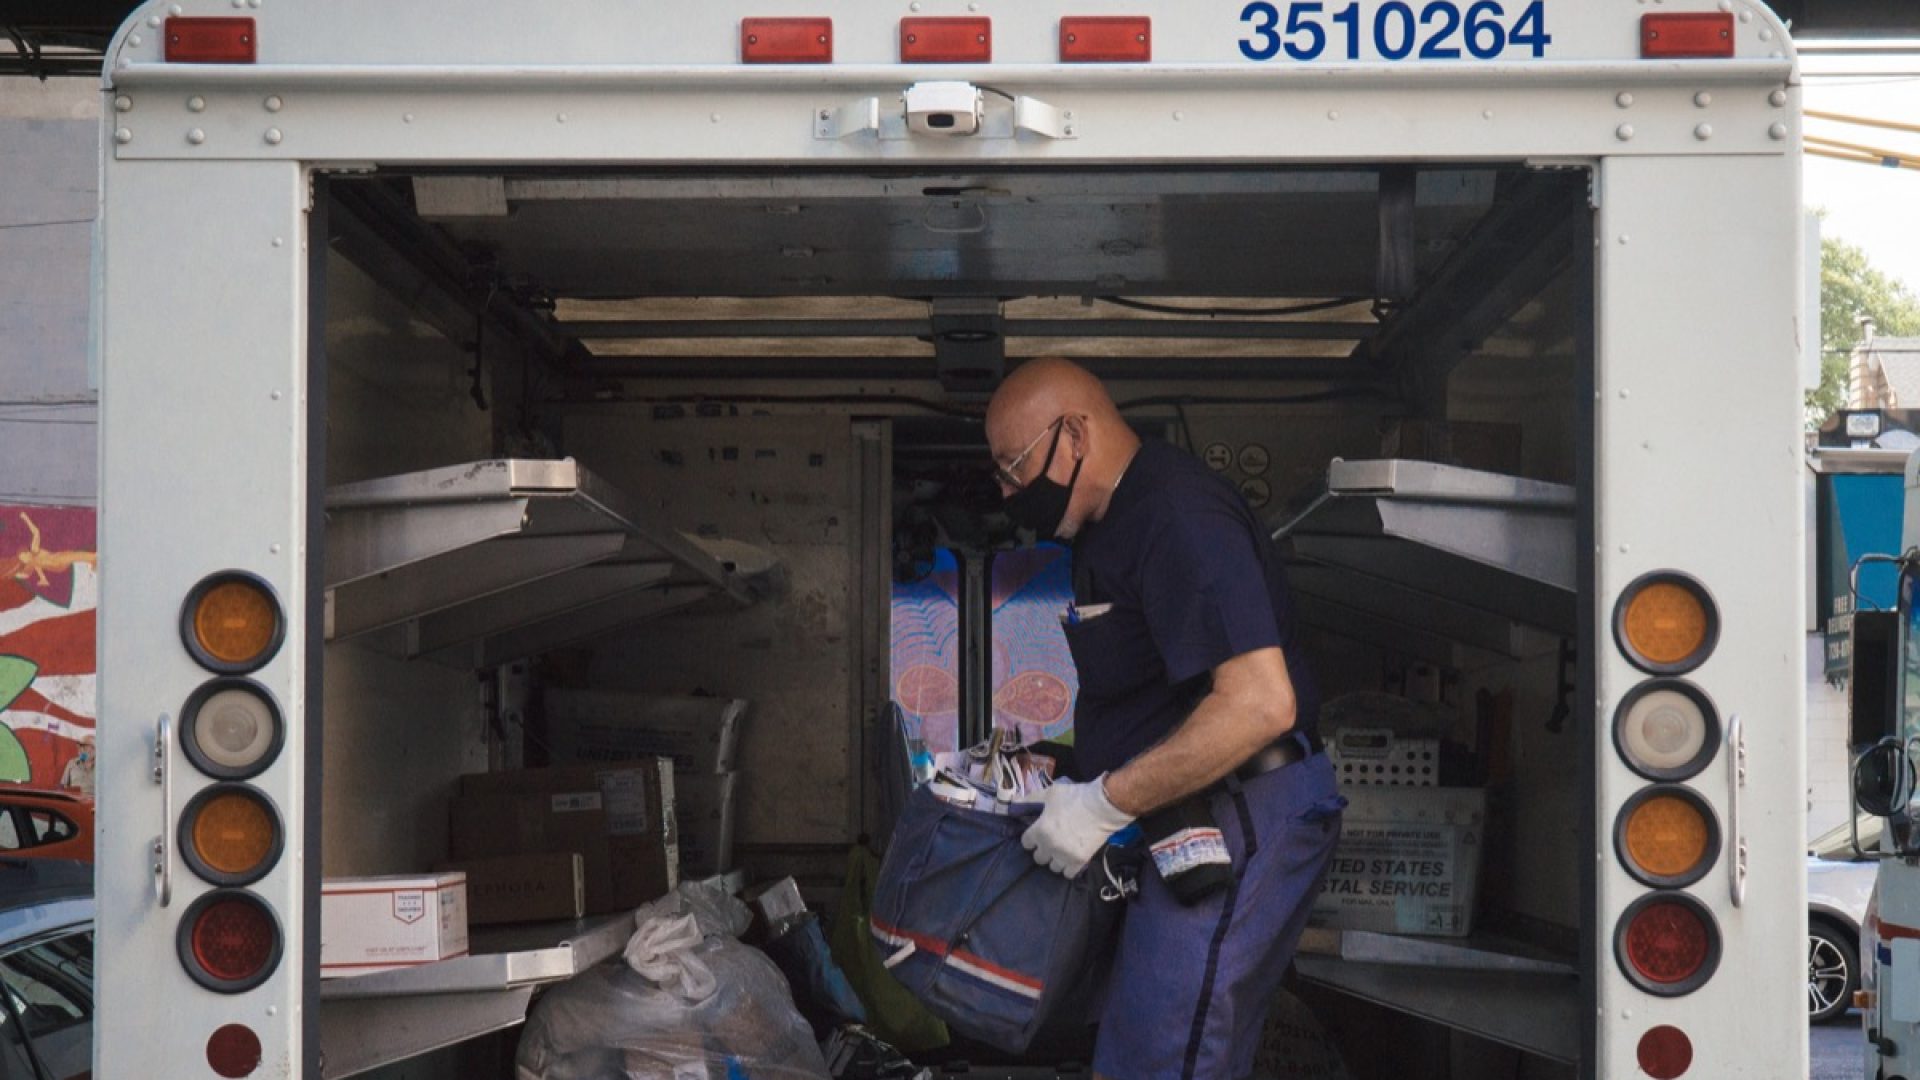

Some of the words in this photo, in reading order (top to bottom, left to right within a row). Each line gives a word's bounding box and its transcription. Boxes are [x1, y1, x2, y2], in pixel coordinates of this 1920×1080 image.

[1238, 0, 1552, 61] 3510264
[1330, 858, 1365, 873] TED
[1371, 860, 1444, 877] STATES
[472, 881, 545, 897] EPHORA
[1319, 878, 1362, 894] STAL
[1369, 880, 1451, 897] SERVICE
